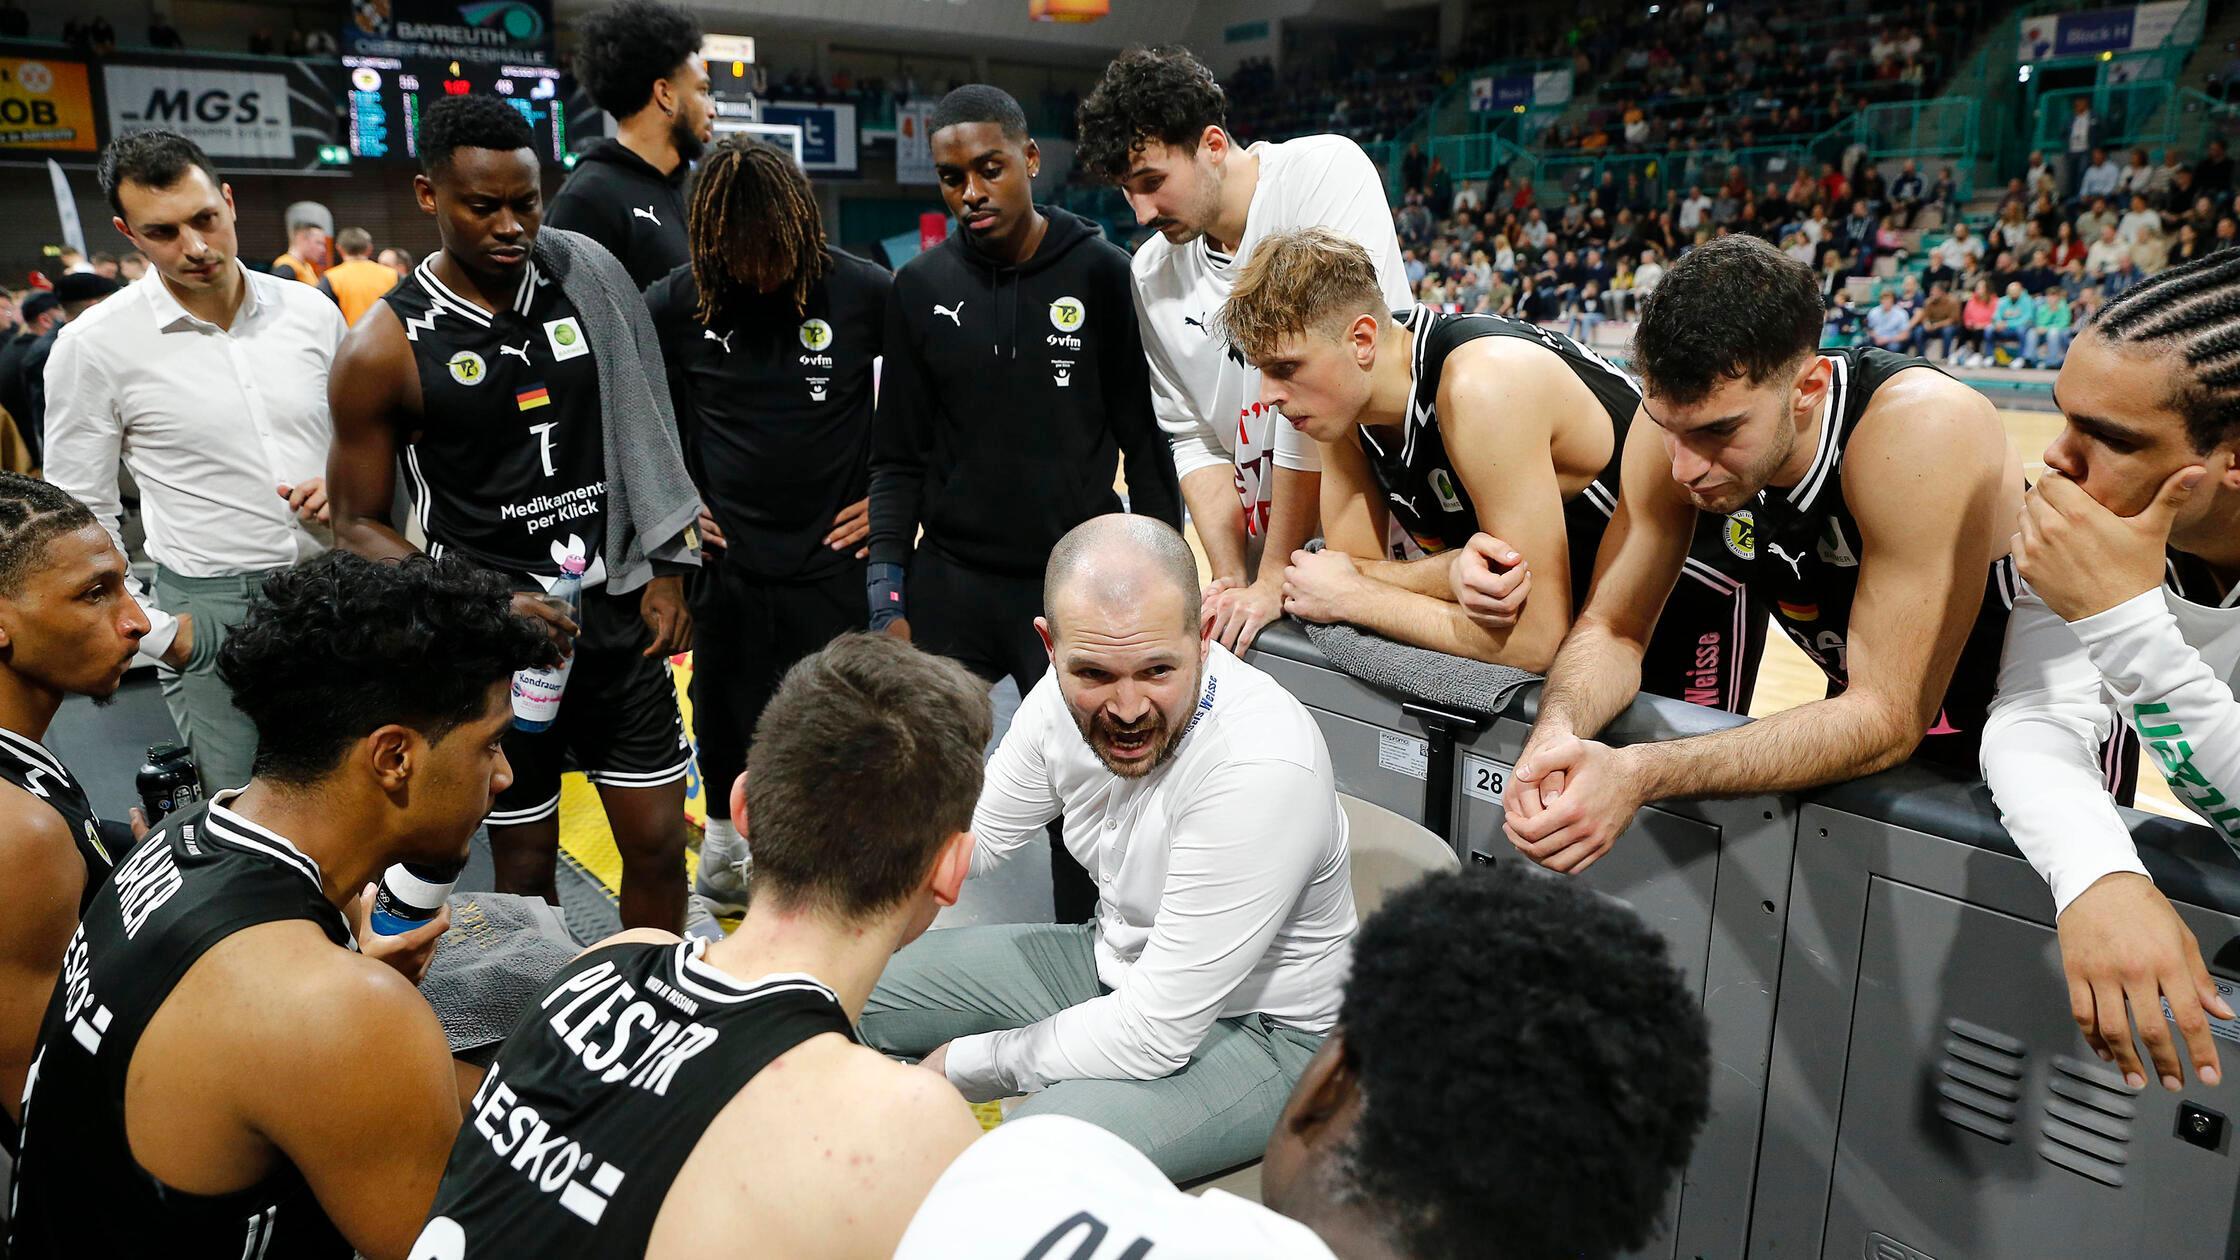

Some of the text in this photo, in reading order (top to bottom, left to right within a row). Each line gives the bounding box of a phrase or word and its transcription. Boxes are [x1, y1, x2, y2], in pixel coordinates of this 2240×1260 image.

[396, 21, 507, 46] BAYREUTH
[0, 98, 58, 126] OB
[1058, 334, 1081, 347] vfm
[810, 354, 833, 366] vfm
[527, 499, 600, 535] per Klick
[1684, 631, 1721, 707] Weisse
[1199, 674, 1218, 712] Weisse
[1476, 768, 1503, 795] 28
[114, 828, 184, 941] BAKER
[63, 920, 92, 1024] ESKO
[666, 989, 700, 1017] PASSION
